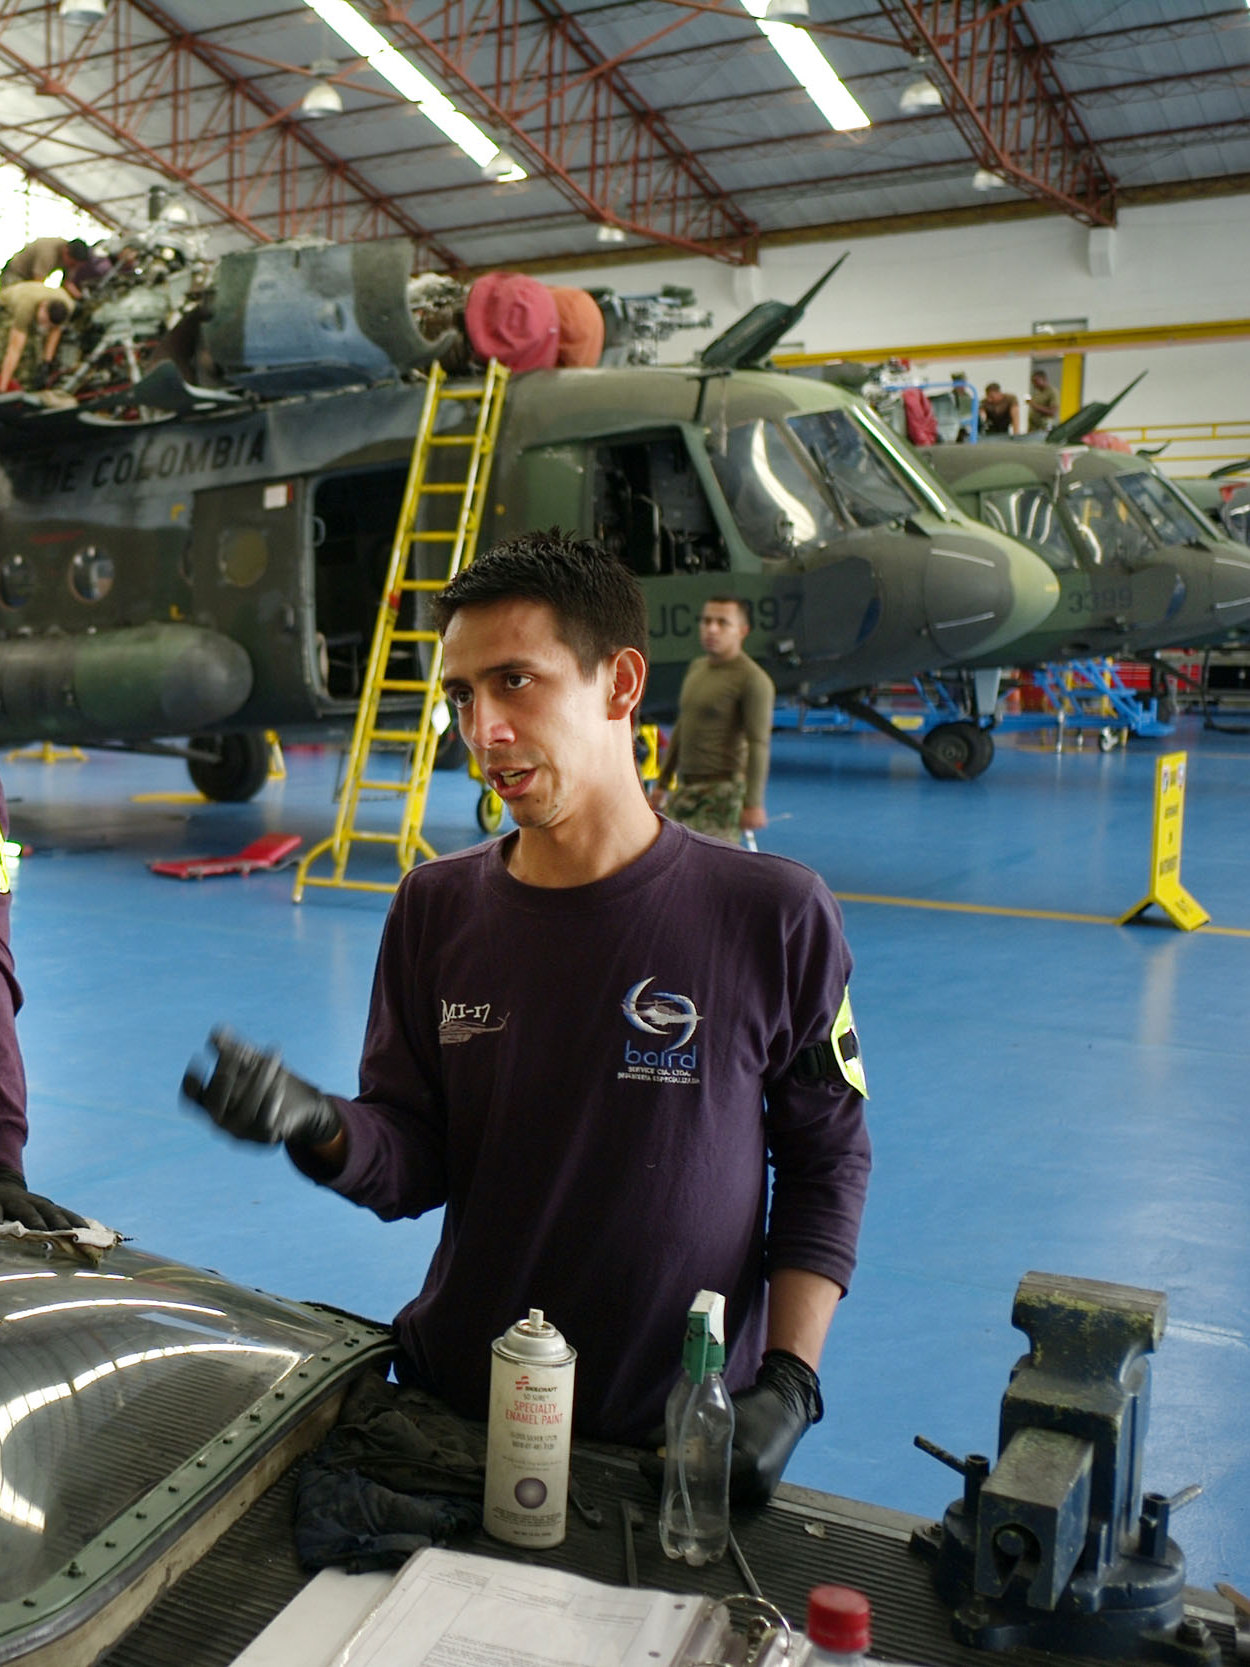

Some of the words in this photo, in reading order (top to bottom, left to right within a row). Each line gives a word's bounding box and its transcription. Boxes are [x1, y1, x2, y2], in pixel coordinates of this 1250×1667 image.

[91, 429, 266, 488] COLOMBIA
[440, 999, 491, 1025] MI-17
[624, 1039, 698, 1070] baird
[505, 1409, 538, 1425] ENAMEL
[541, 1413, 564, 1425] PAINT
[514, 1400, 557, 1414] SPECIALTY
